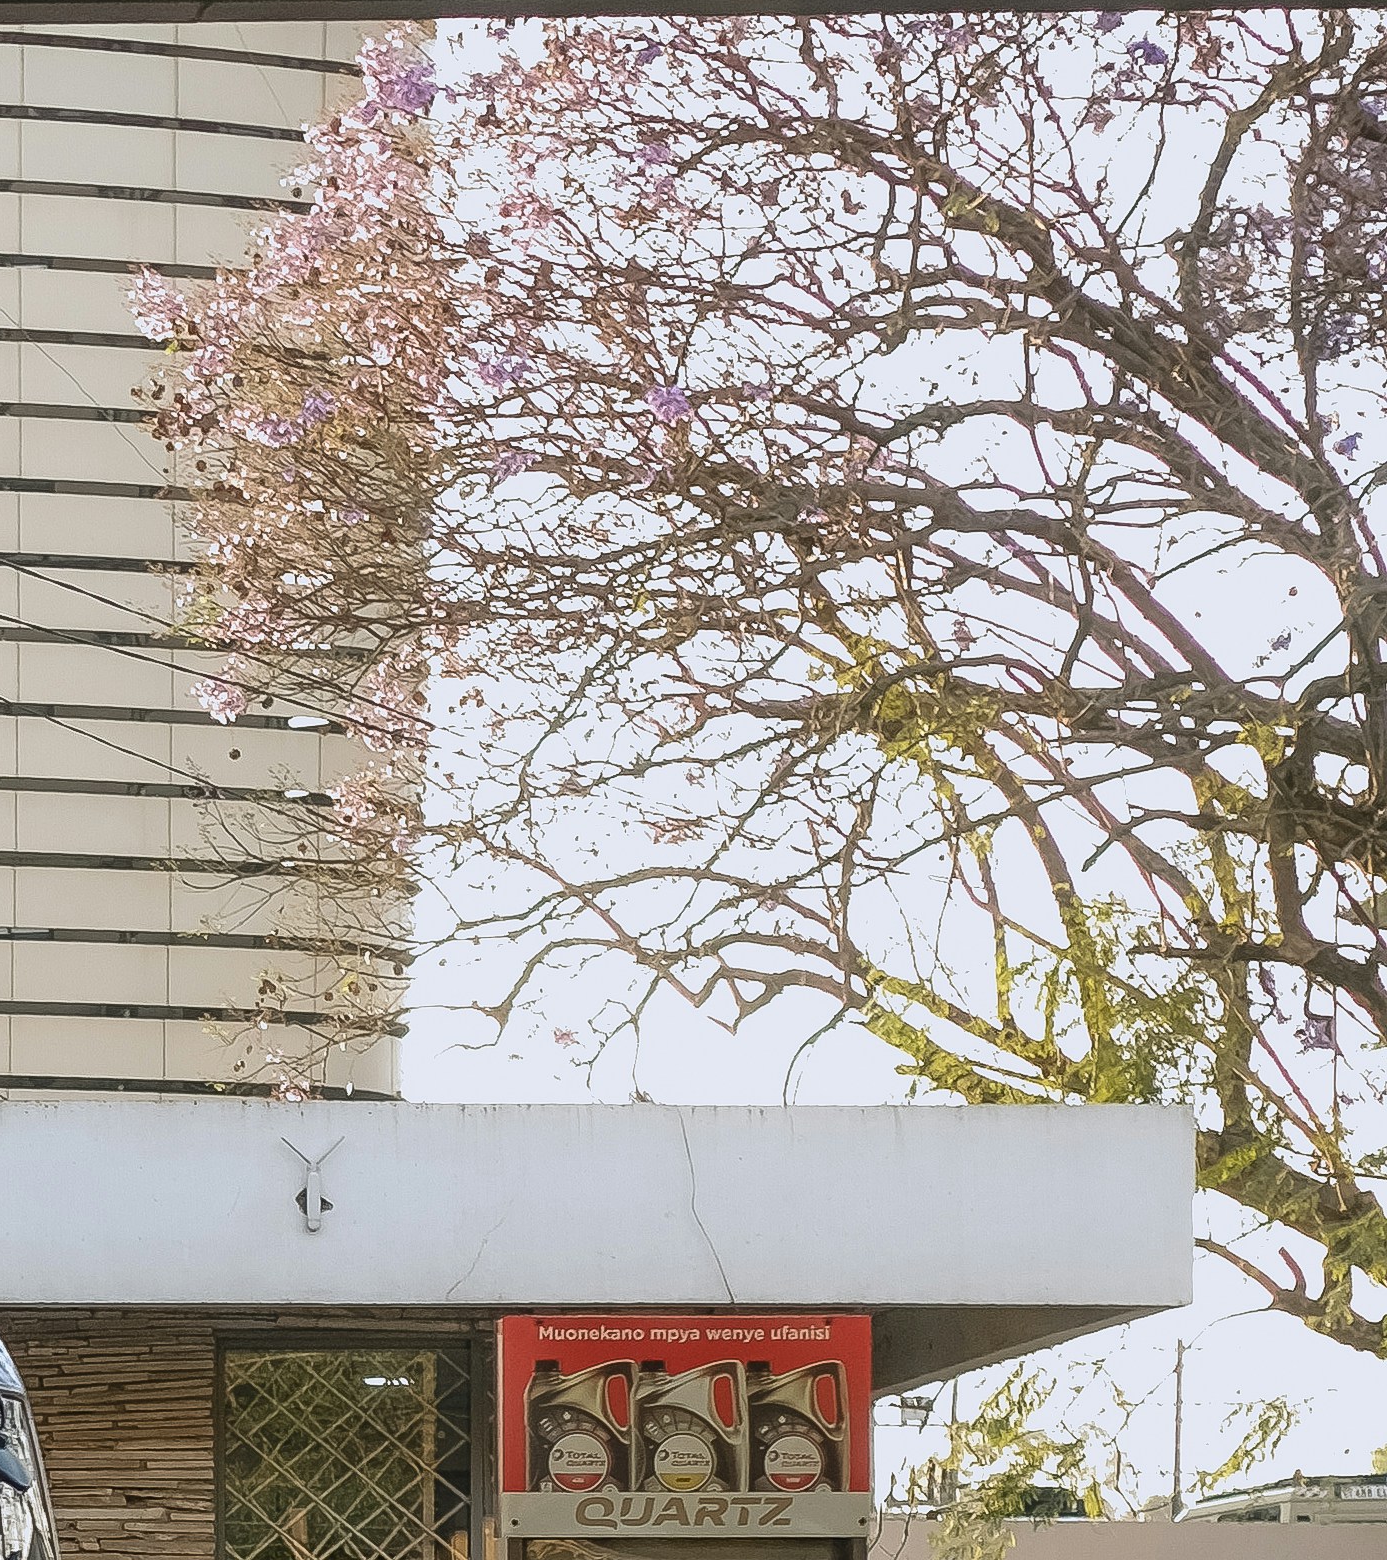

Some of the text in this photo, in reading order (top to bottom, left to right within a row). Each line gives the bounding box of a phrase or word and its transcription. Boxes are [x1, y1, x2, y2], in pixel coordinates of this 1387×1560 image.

[538, 1325, 831, 1343] Muonekano mpya wenye ufanisi
[575, 1496, 794, 1530] QUARTZ
